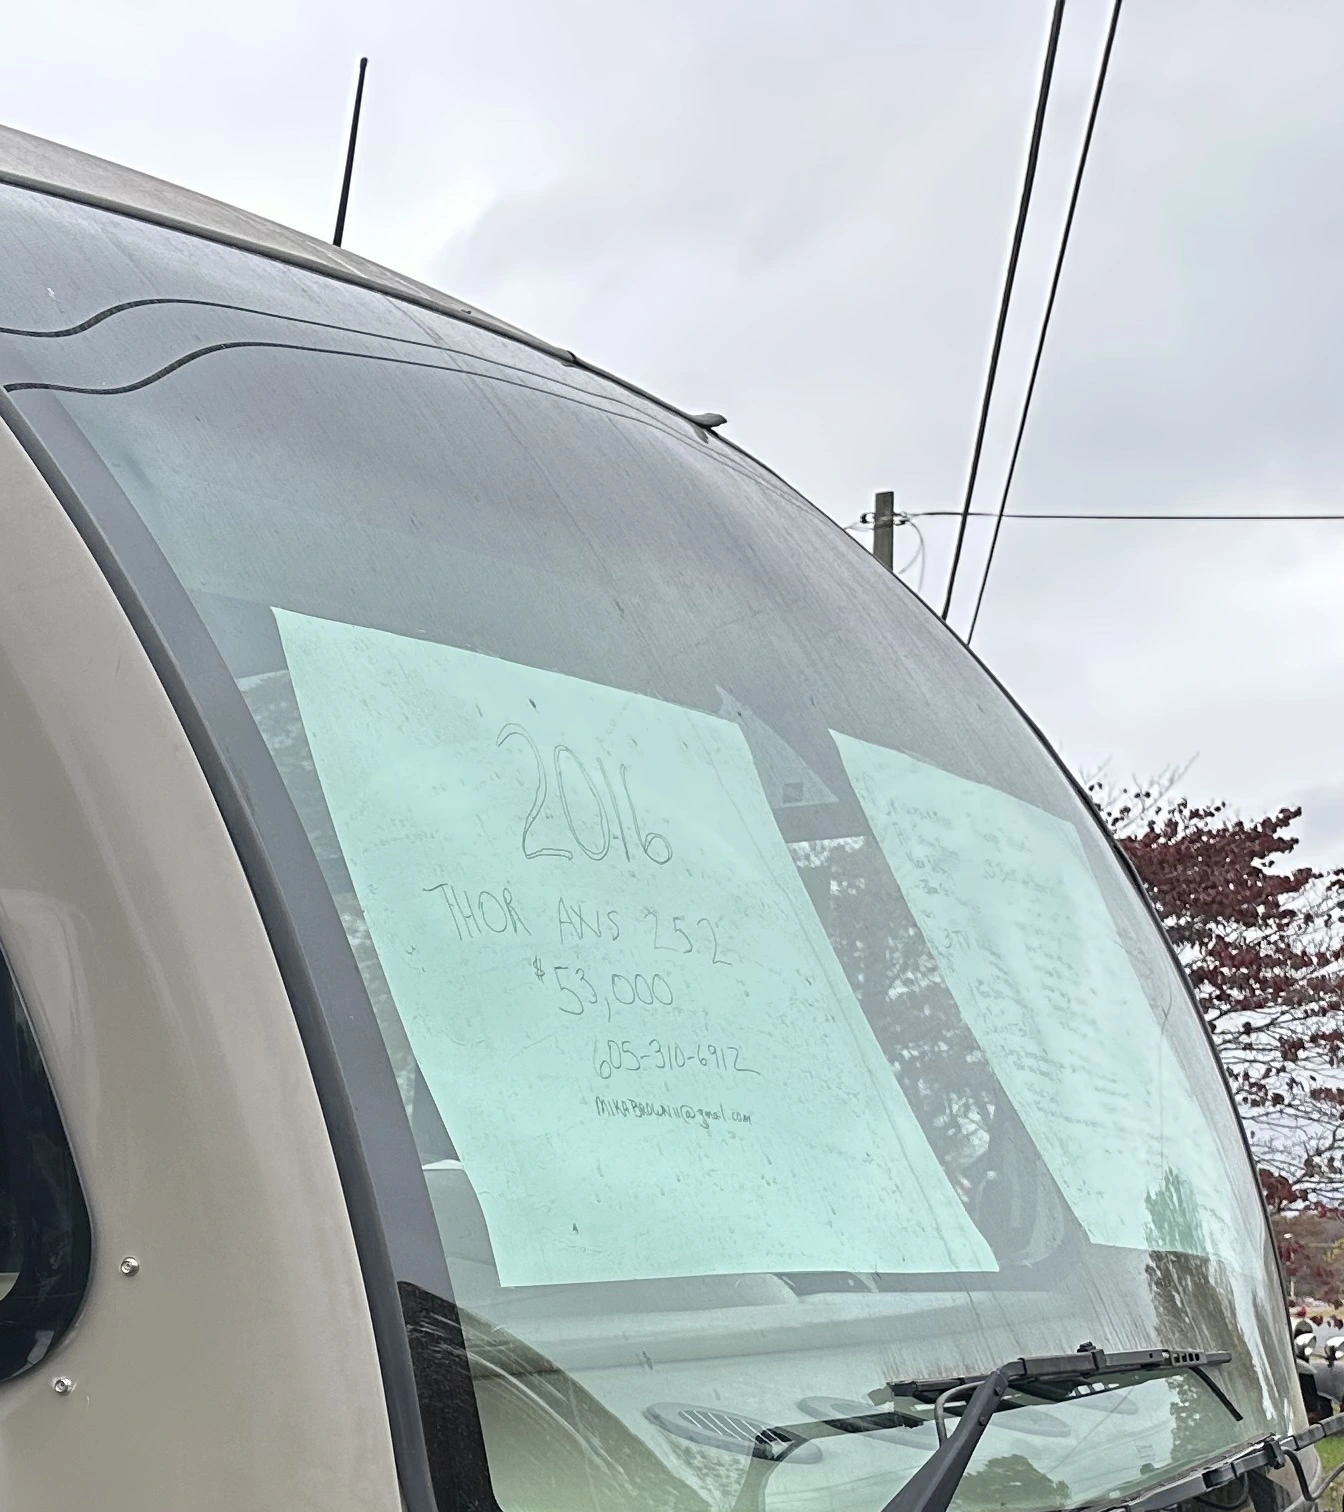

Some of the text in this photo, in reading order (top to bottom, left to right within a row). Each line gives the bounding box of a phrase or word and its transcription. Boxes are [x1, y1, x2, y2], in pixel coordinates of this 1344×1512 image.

[496, 722, 673, 866] 2016
[422, 882, 532, 941] THOR
[557, 896, 620, 944] AXIS
[528, 955, 674, 1023] $53,000
[592, 1037, 761, 1080] 605-310-6912
